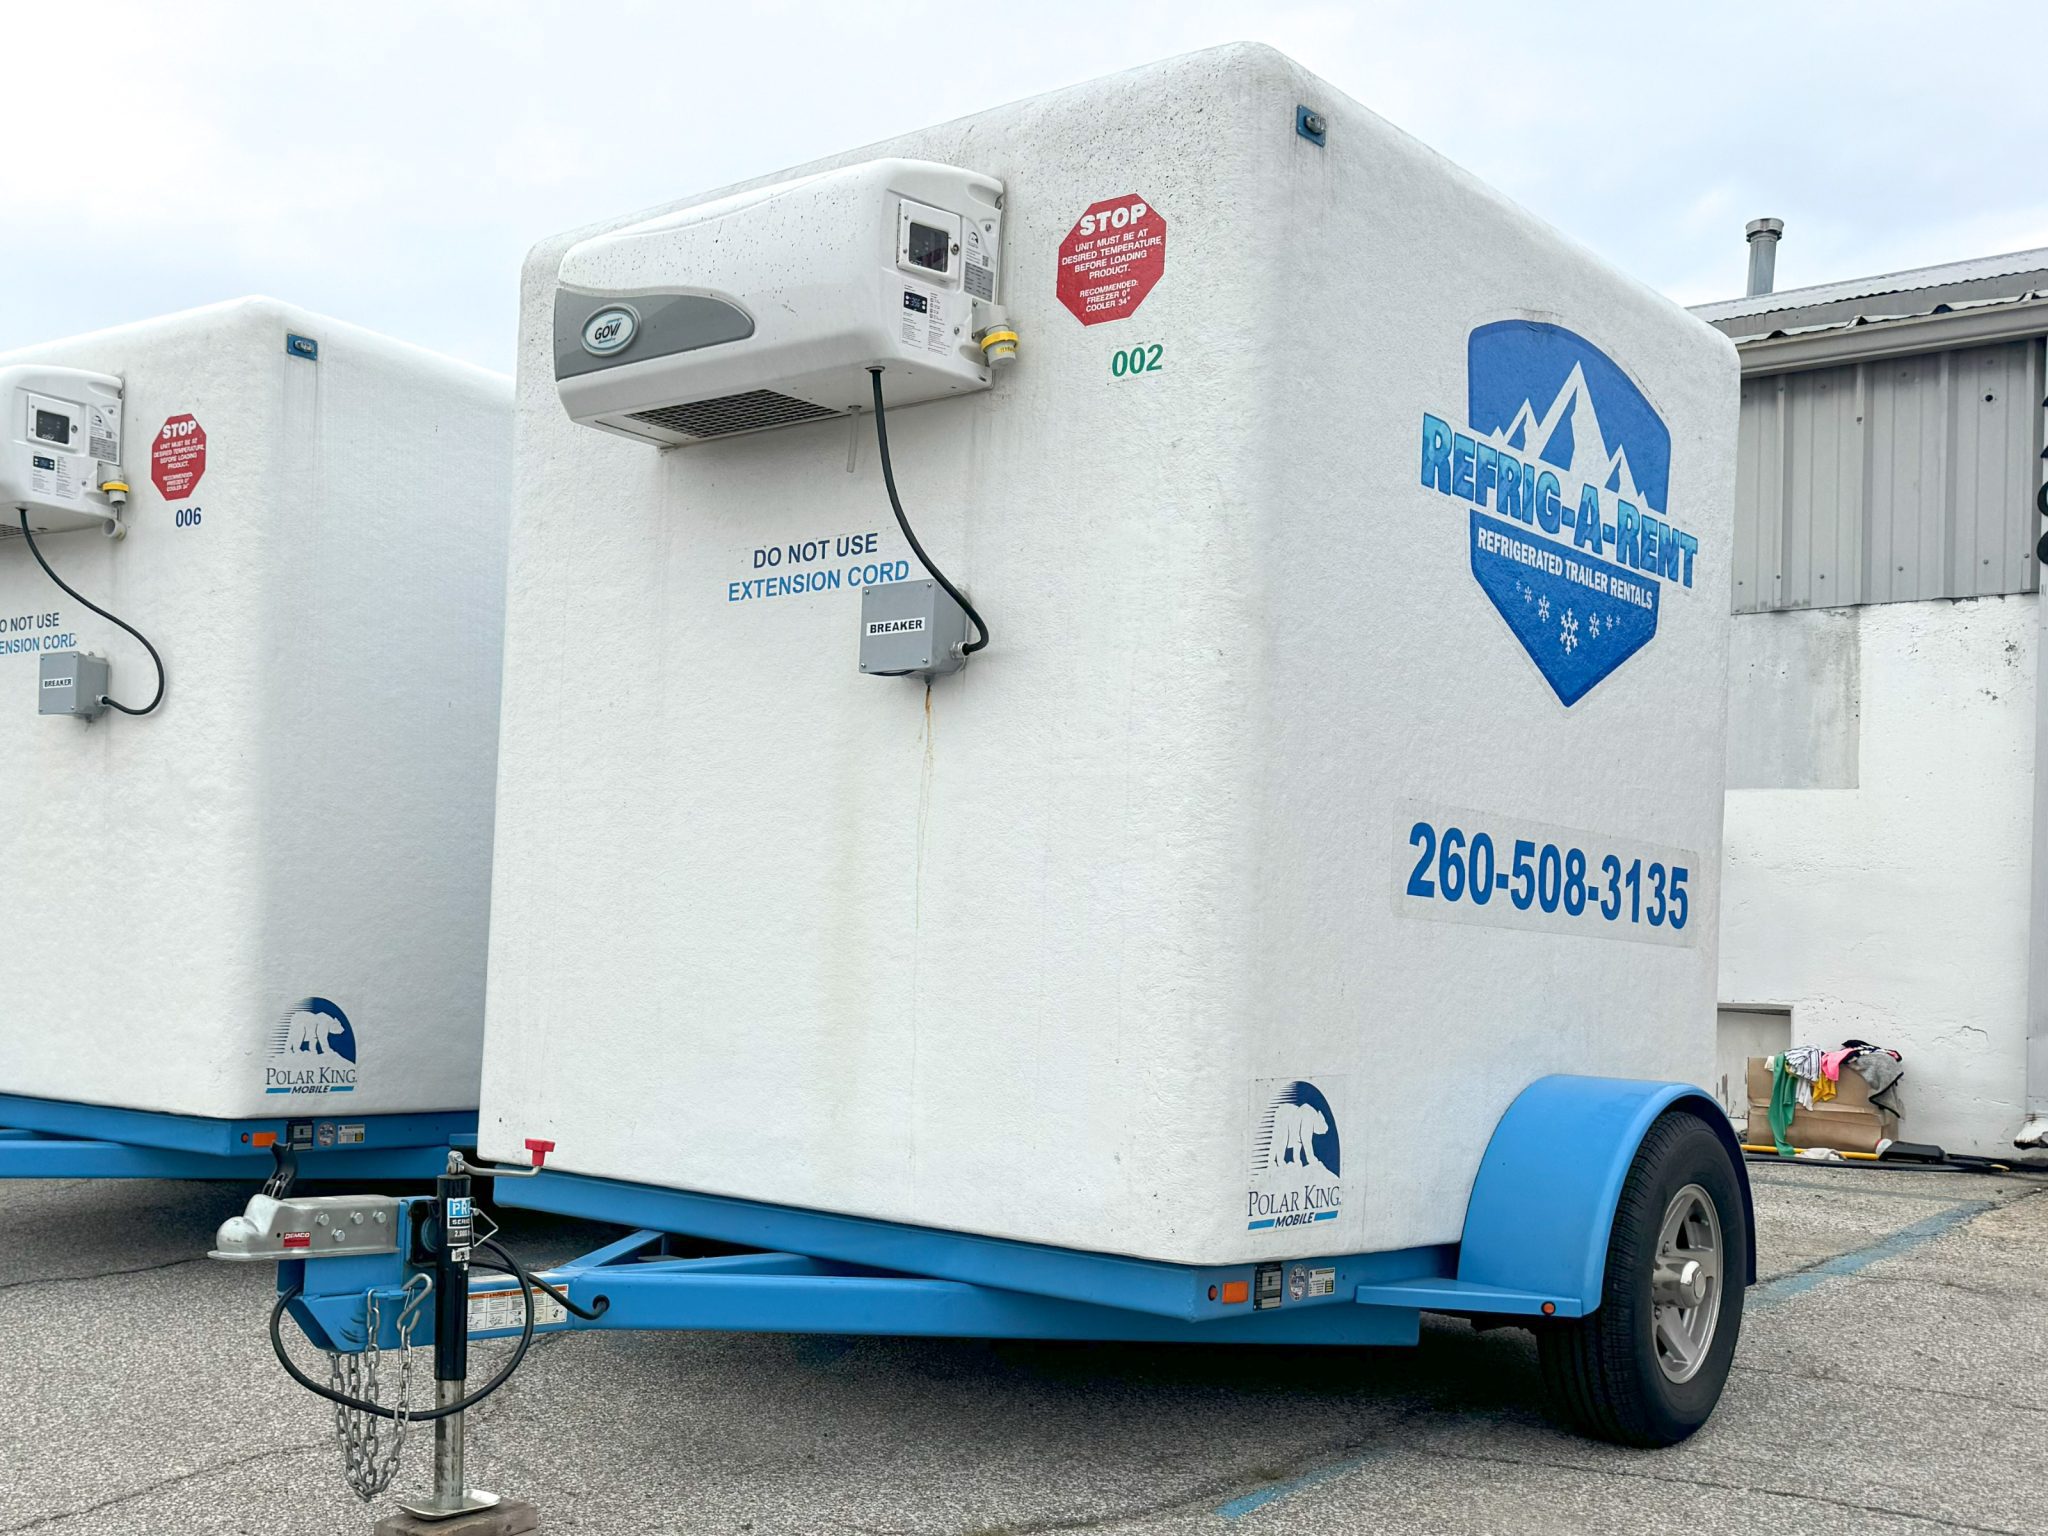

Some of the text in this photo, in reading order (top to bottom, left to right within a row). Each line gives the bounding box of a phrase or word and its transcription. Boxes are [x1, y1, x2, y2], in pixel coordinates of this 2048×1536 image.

[1080, 203, 1147, 236] STOP
[1075, 228, 1148, 252] UNIT MUST BE AT
[1061, 251, 1097, 265] DESIRED
[1074, 250, 1147, 272] BEFORE LOADING
[1089, 264, 1131, 279] PRODUCT.
[1085, 299, 1116, 313] COOLER
[1086, 290, 1119, 304] FREEZER
[1111, 344, 1164, 377] 002
[162, 420, 197, 439] STOP
[1420, 412, 1699, 589] REFRIG-A-RENT
[175, 507, 202, 528] 006
[753, 532, 878, 569] DO NOT USE
[1477, 527, 1653, 610] REFRIGERATED TRAILER RENTALS
[728, 560, 910, 602] EXTENSION CORD
[0, 612, 60, 633] O NOT USE
[869, 619, 923, 634] BREAKER
[0, 633, 77, 655] ENSION CORD
[44, 678, 72, 688] BREAKER
[1406, 822, 1689, 930] 260-508-3135
[291, 1085, 330, 1094] MOBILE
[1274, 1212, 1315, 1228] MOBILE
